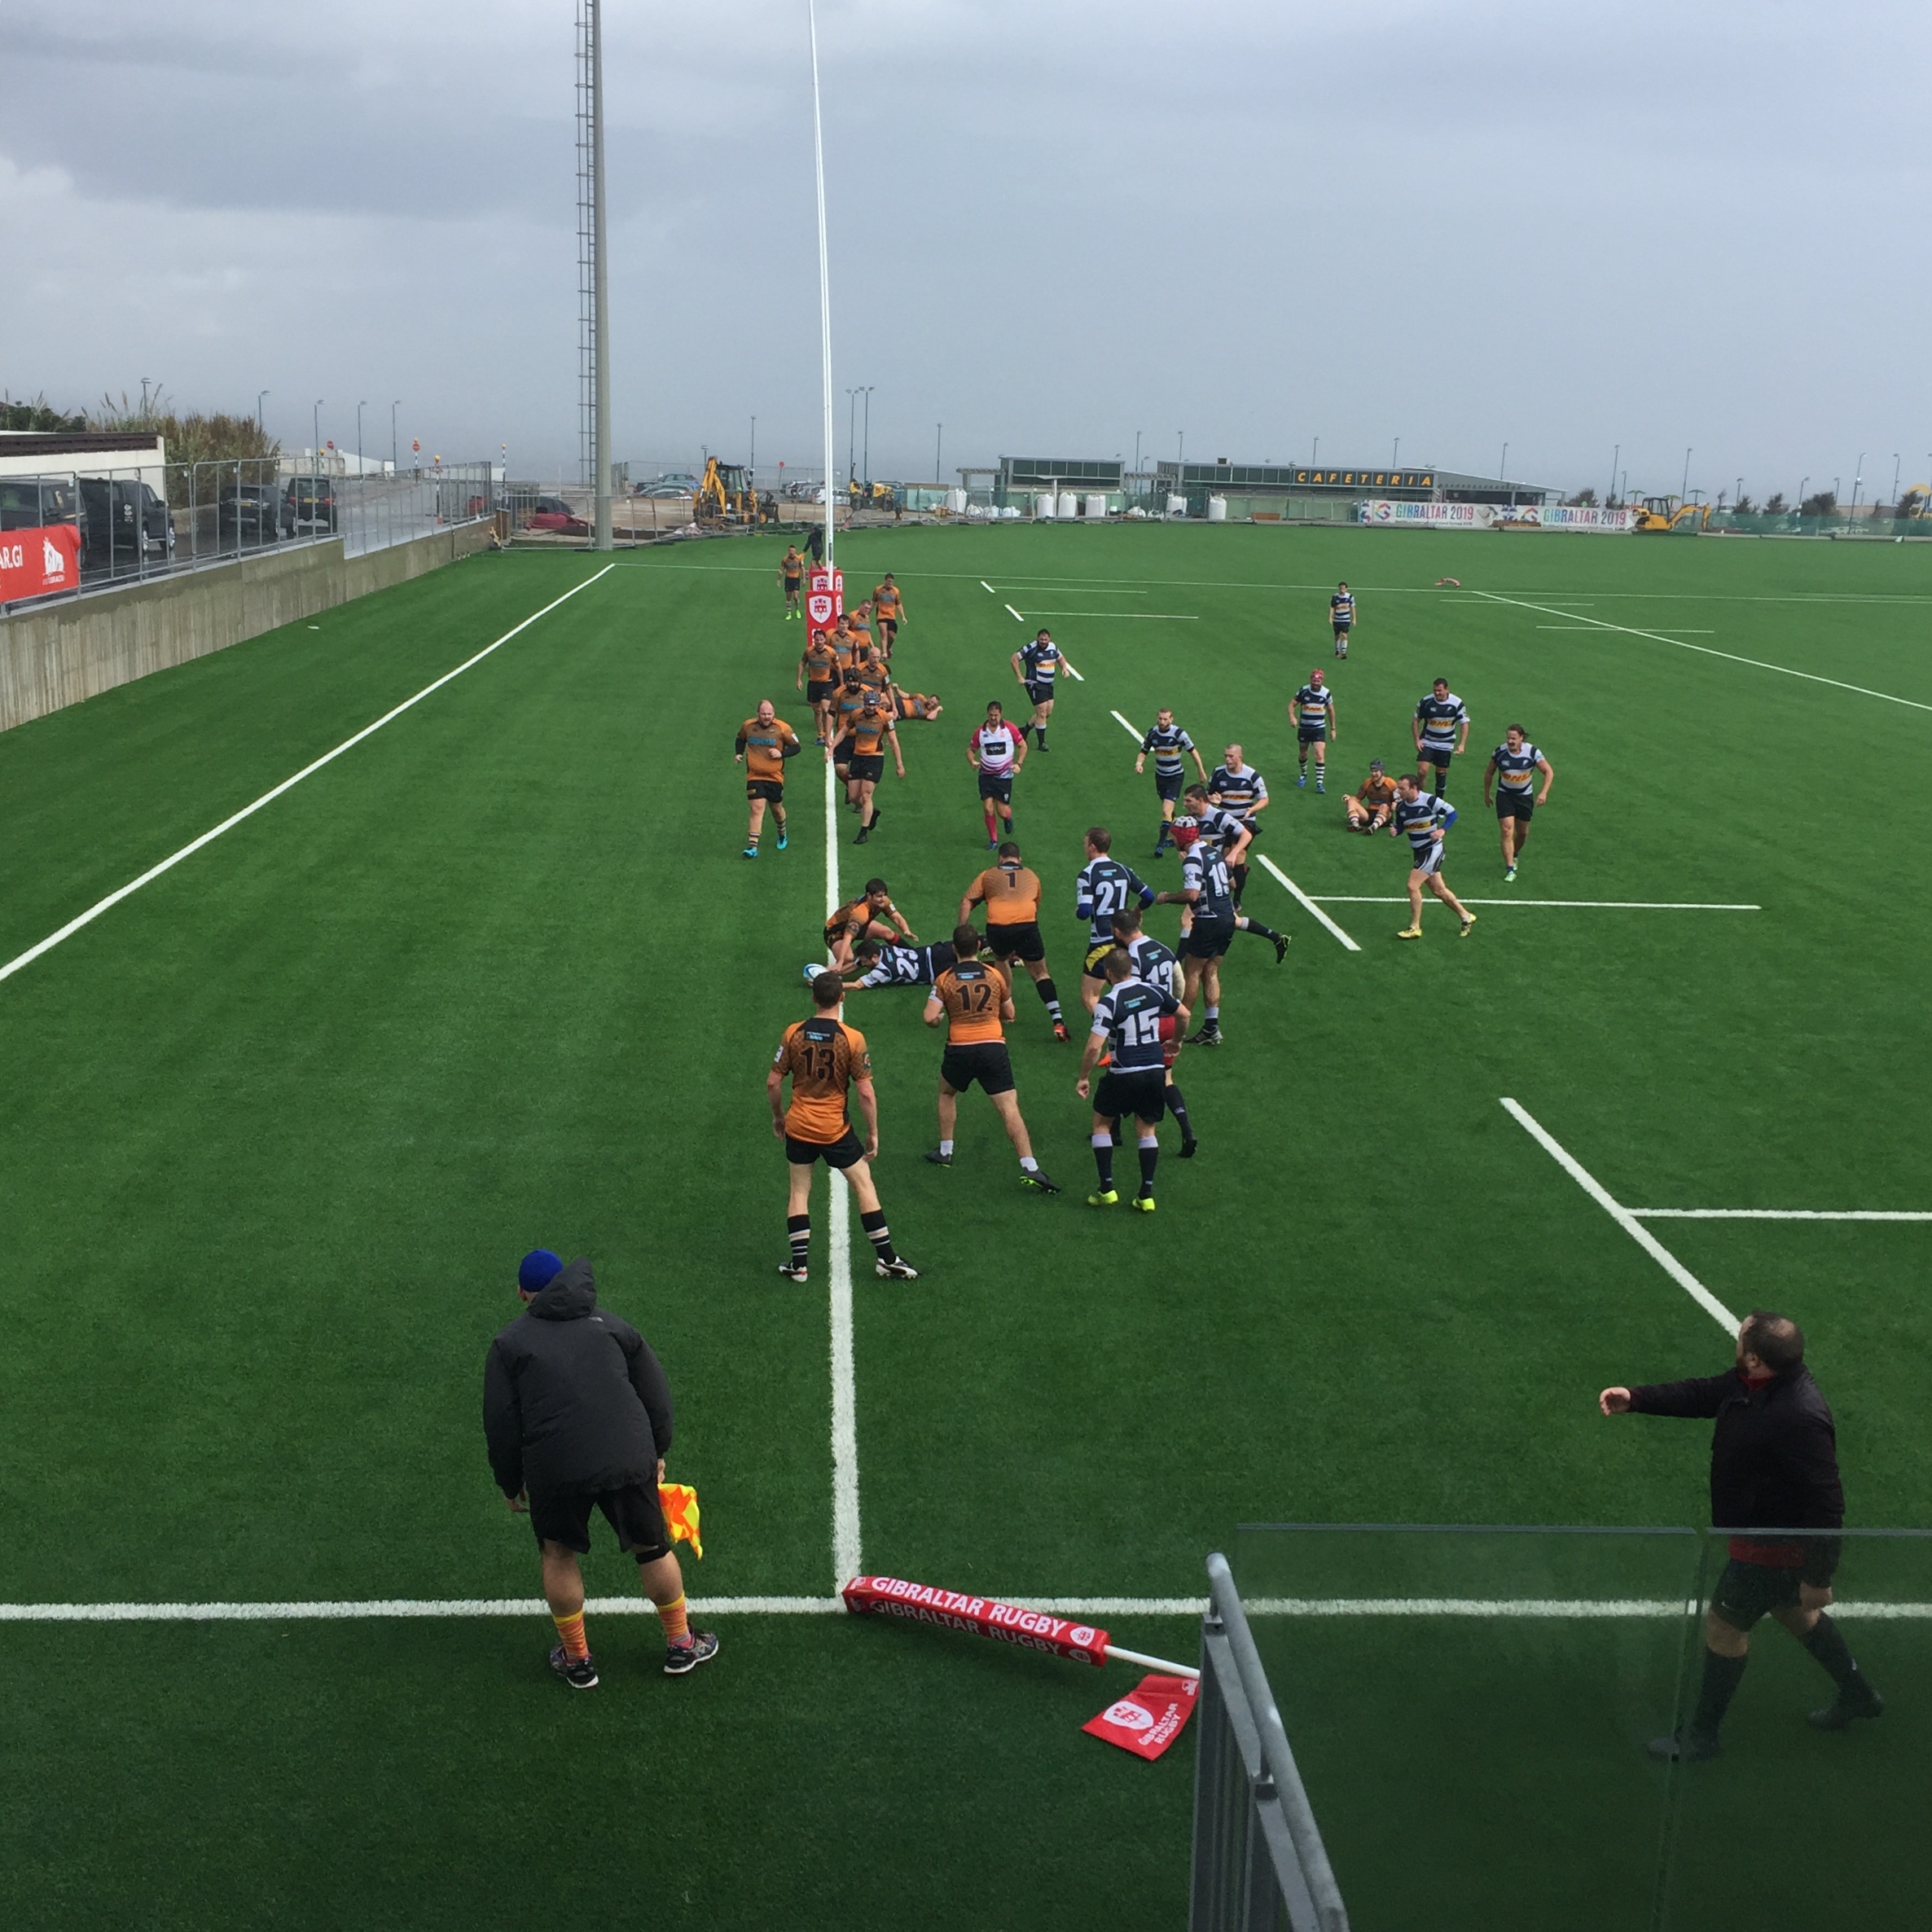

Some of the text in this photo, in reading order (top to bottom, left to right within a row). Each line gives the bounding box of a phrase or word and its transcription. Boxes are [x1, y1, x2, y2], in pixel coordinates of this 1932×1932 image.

[1298, 472, 1432, 486] CAFETERIA
[1396, 503, 1474, 520] GIBRALTAR 2019
[1543, 509, 1627, 525] GIBRALTAR 2019
[1004, 872, 1016, 888] 1
[1096, 880, 1127, 916] 27
[955, 983, 992, 1012] 12
[1117, 1006, 1161, 1047] 15
[800, 1046, 836, 1080] 13
[872, 1577, 1068, 1637] GIBRALTAR RUGBY
[869, 1600, 1060, 1655] GIBRALTAR RUGBY
[1138, 1703, 1179, 1746] GIBRALTAR
[1153, 1714, 1181, 1744] RUGBY
